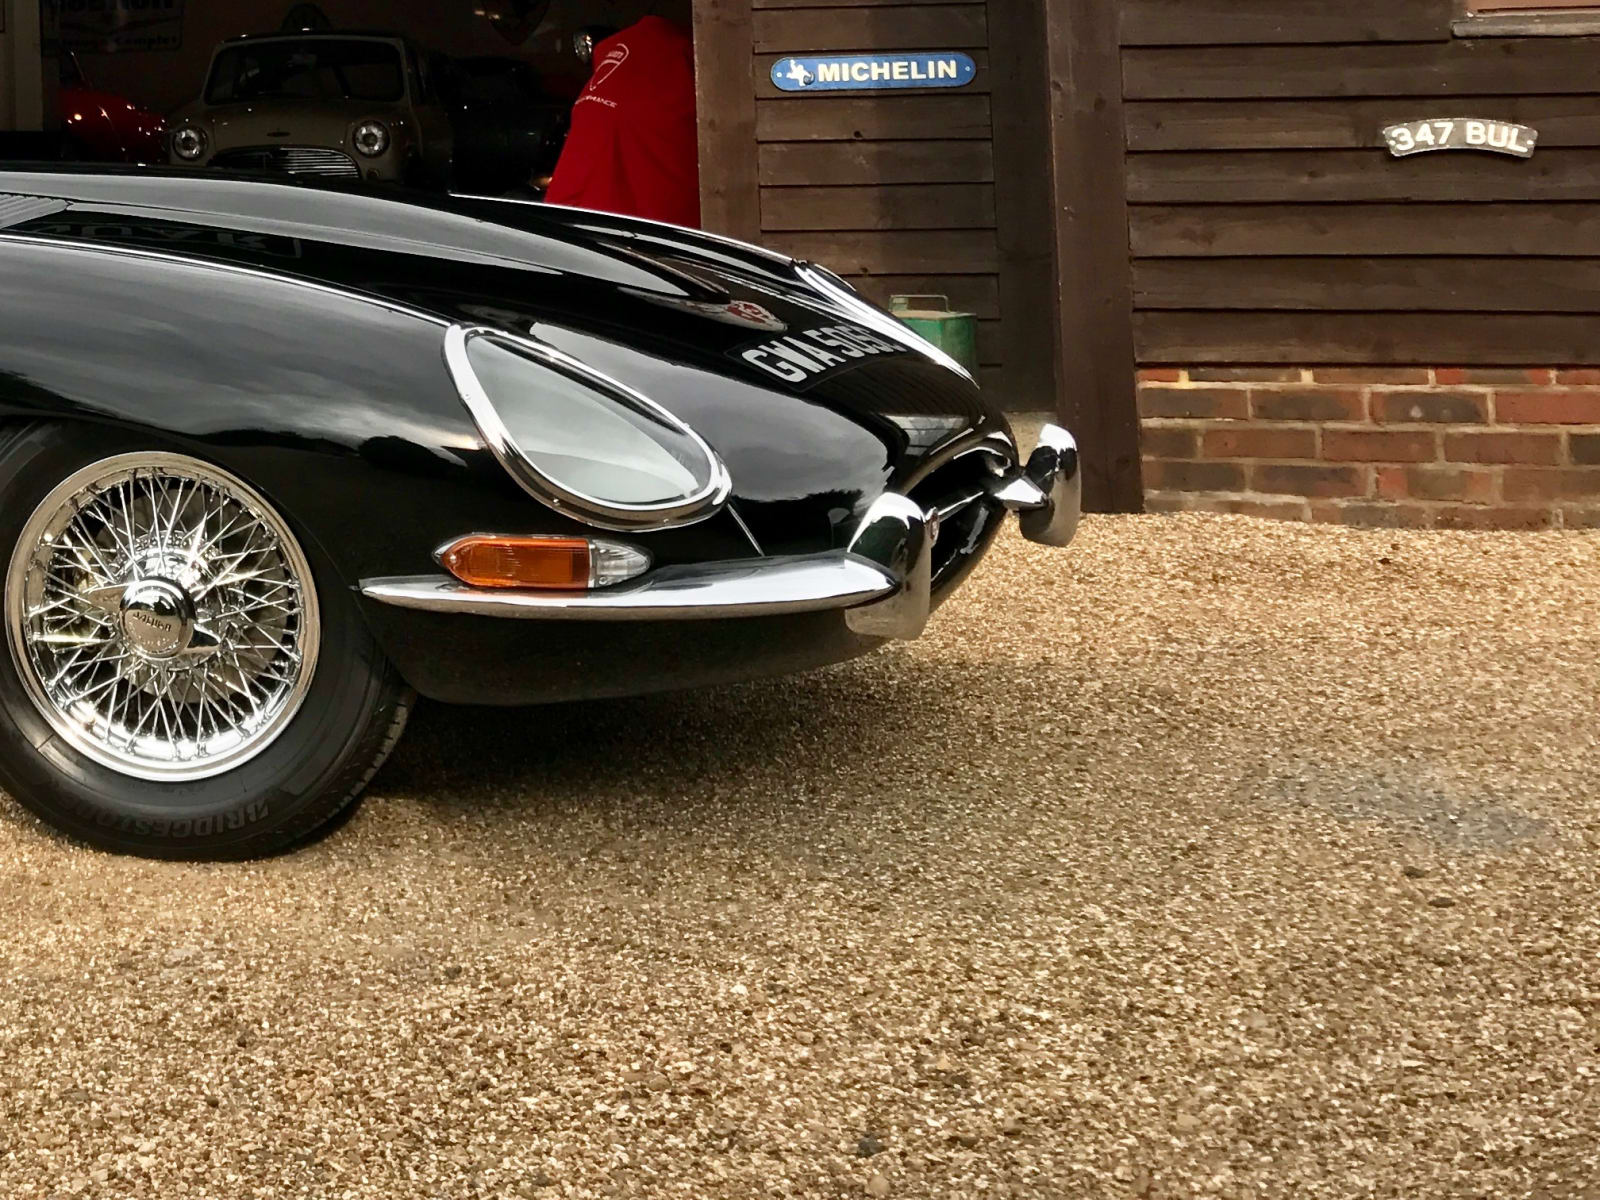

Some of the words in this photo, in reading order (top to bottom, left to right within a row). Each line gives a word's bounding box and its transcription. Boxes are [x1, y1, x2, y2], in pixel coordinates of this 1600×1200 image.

[816, 59, 958, 83] MICHELIN
[1390, 120, 1454, 152] 347
[1464, 120, 1530, 154] BUL
[741, 335, 848, 384] GWA
